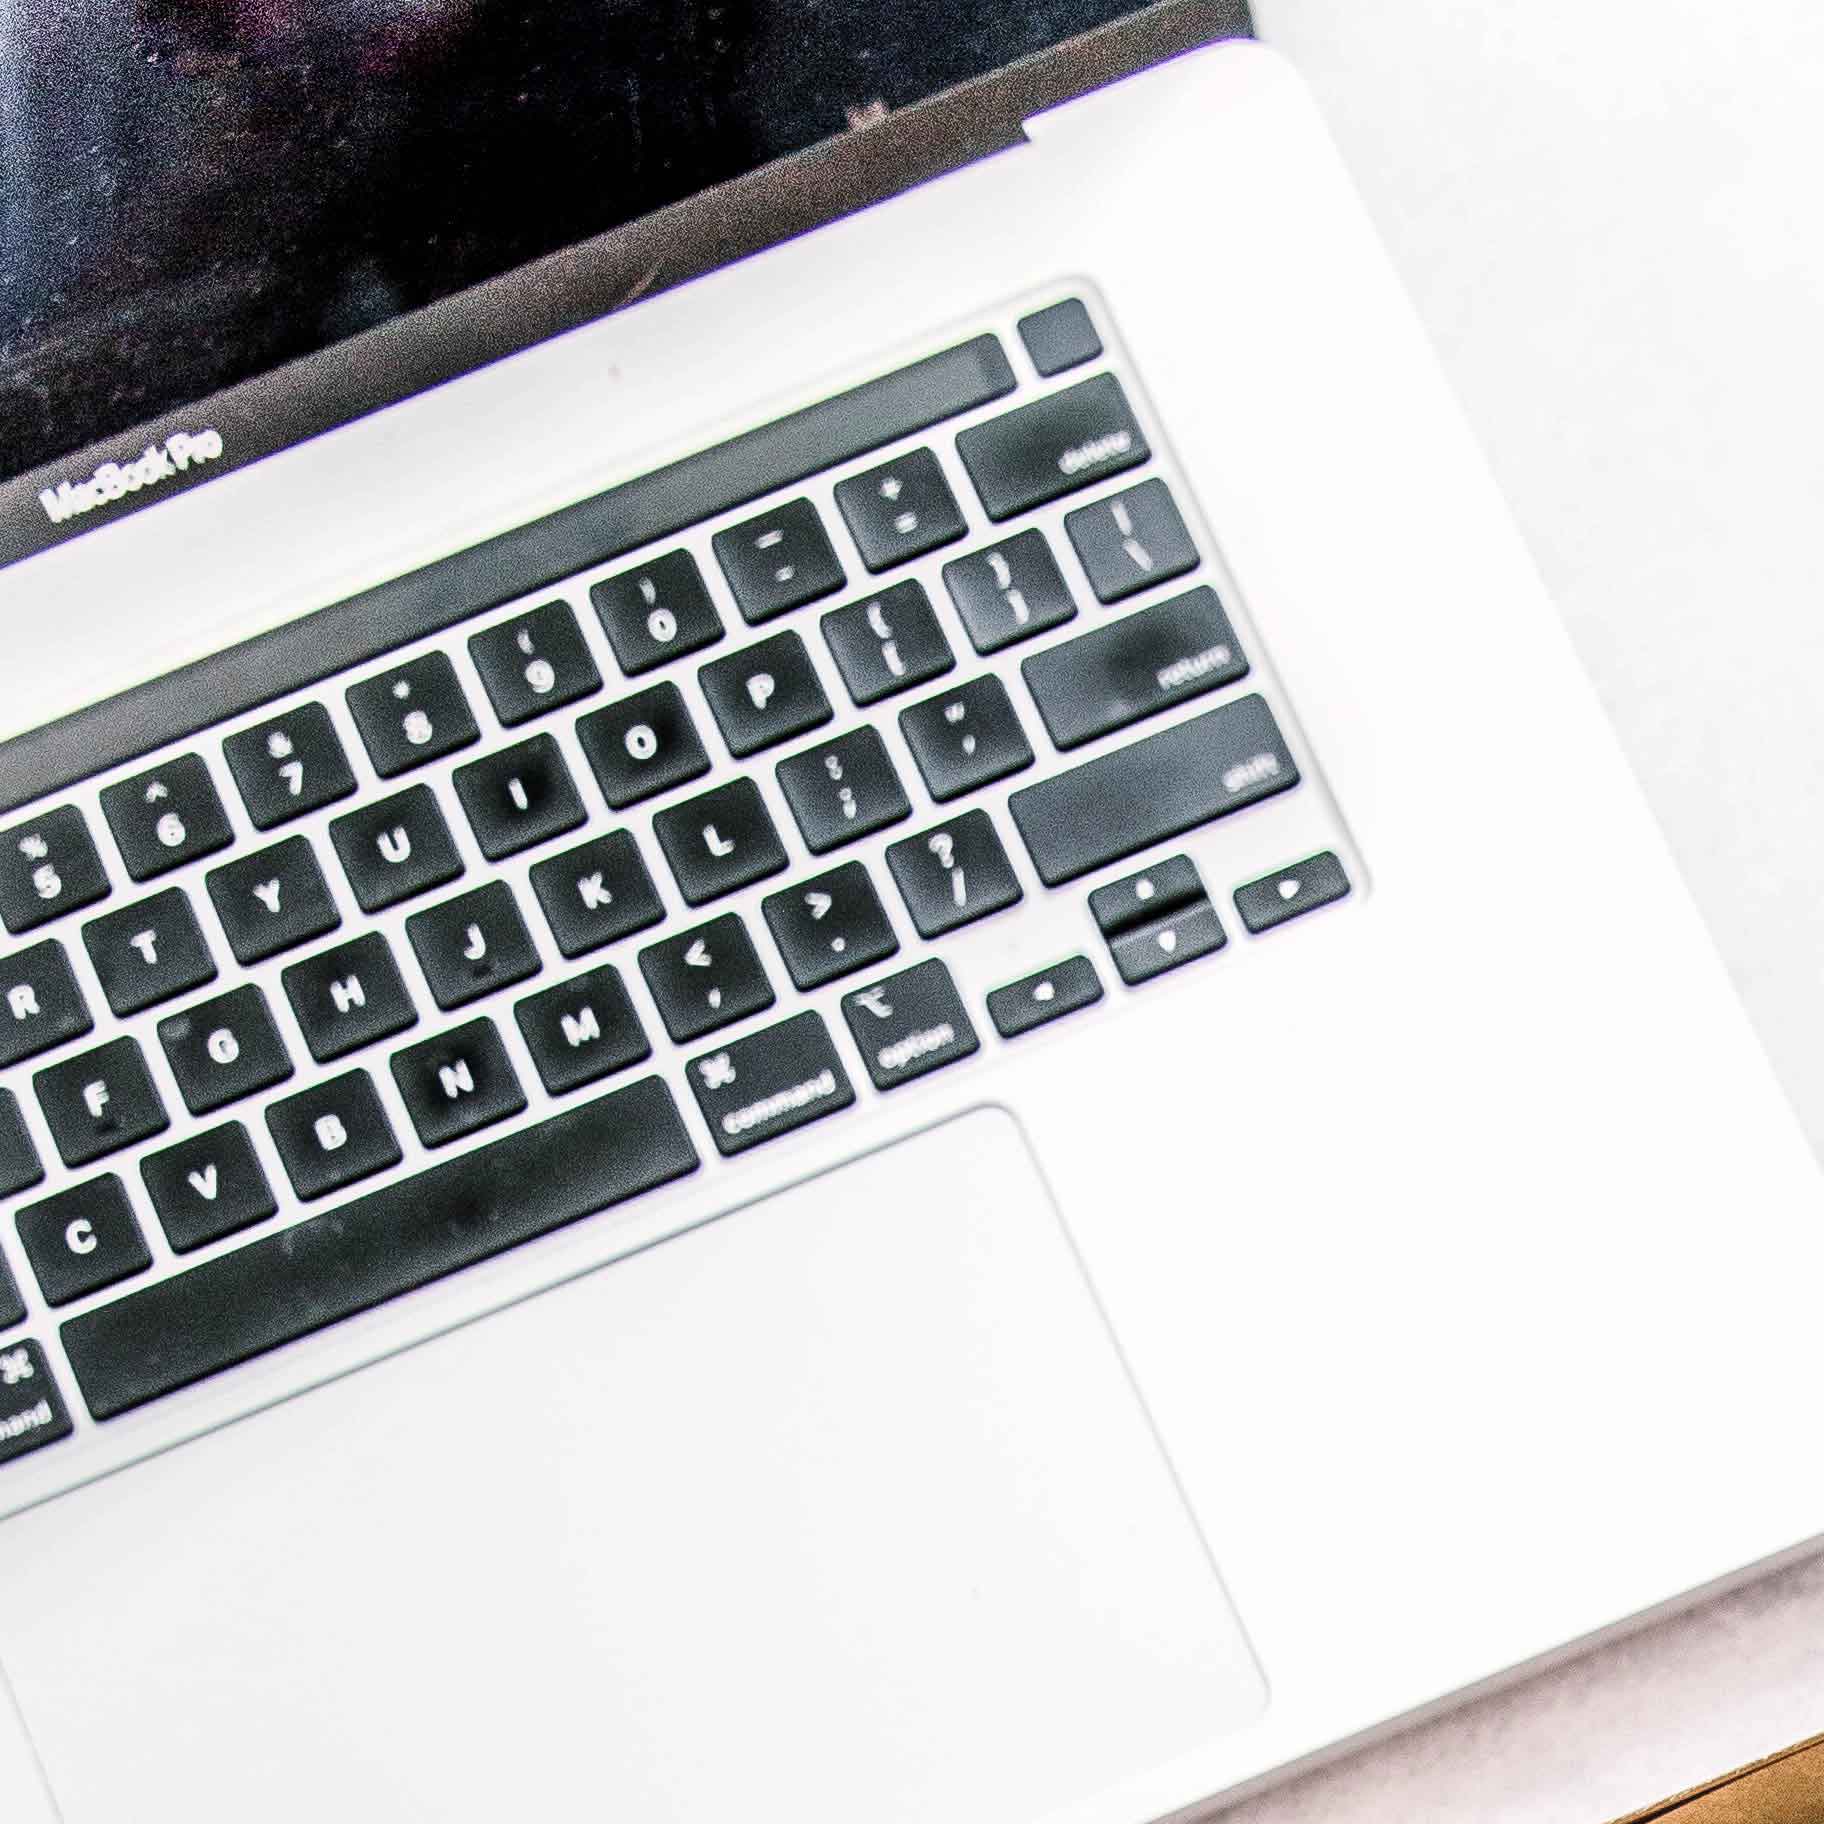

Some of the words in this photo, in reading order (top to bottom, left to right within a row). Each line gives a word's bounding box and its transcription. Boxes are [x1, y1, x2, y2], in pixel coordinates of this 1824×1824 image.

[40, 447, 176, 523] MacBook
[166, 430, 223, 470] Pro
[647, 609, 677, 643] 0
[525, 660, 555, 694] 9
[747, 674, 774, 709] P
[403, 711, 433, 744] 8
[279, 761, 303, 795] 7
[156, 813, 186, 847] 6
[377, 826, 411, 863] U
[703, 825, 733, 856] L
[253, 879, 280, 913] Y
[578, 873, 611, 909] K
[130, 930, 157, 964] T
[464, 923, 486, 960] J
[7, 984, 40, 1020] R
[330, 975, 365, 1012] H
[561, 1007, 600, 1046] M
[439, 1061, 474, 1097] N
[83, 1081, 109, 1117] F
[722, 1069, 837, 1135] command
[315, 1115, 347, 1150] B
[188, 1165, 217, 1200] V
[66, 1219, 97, 1254] C
